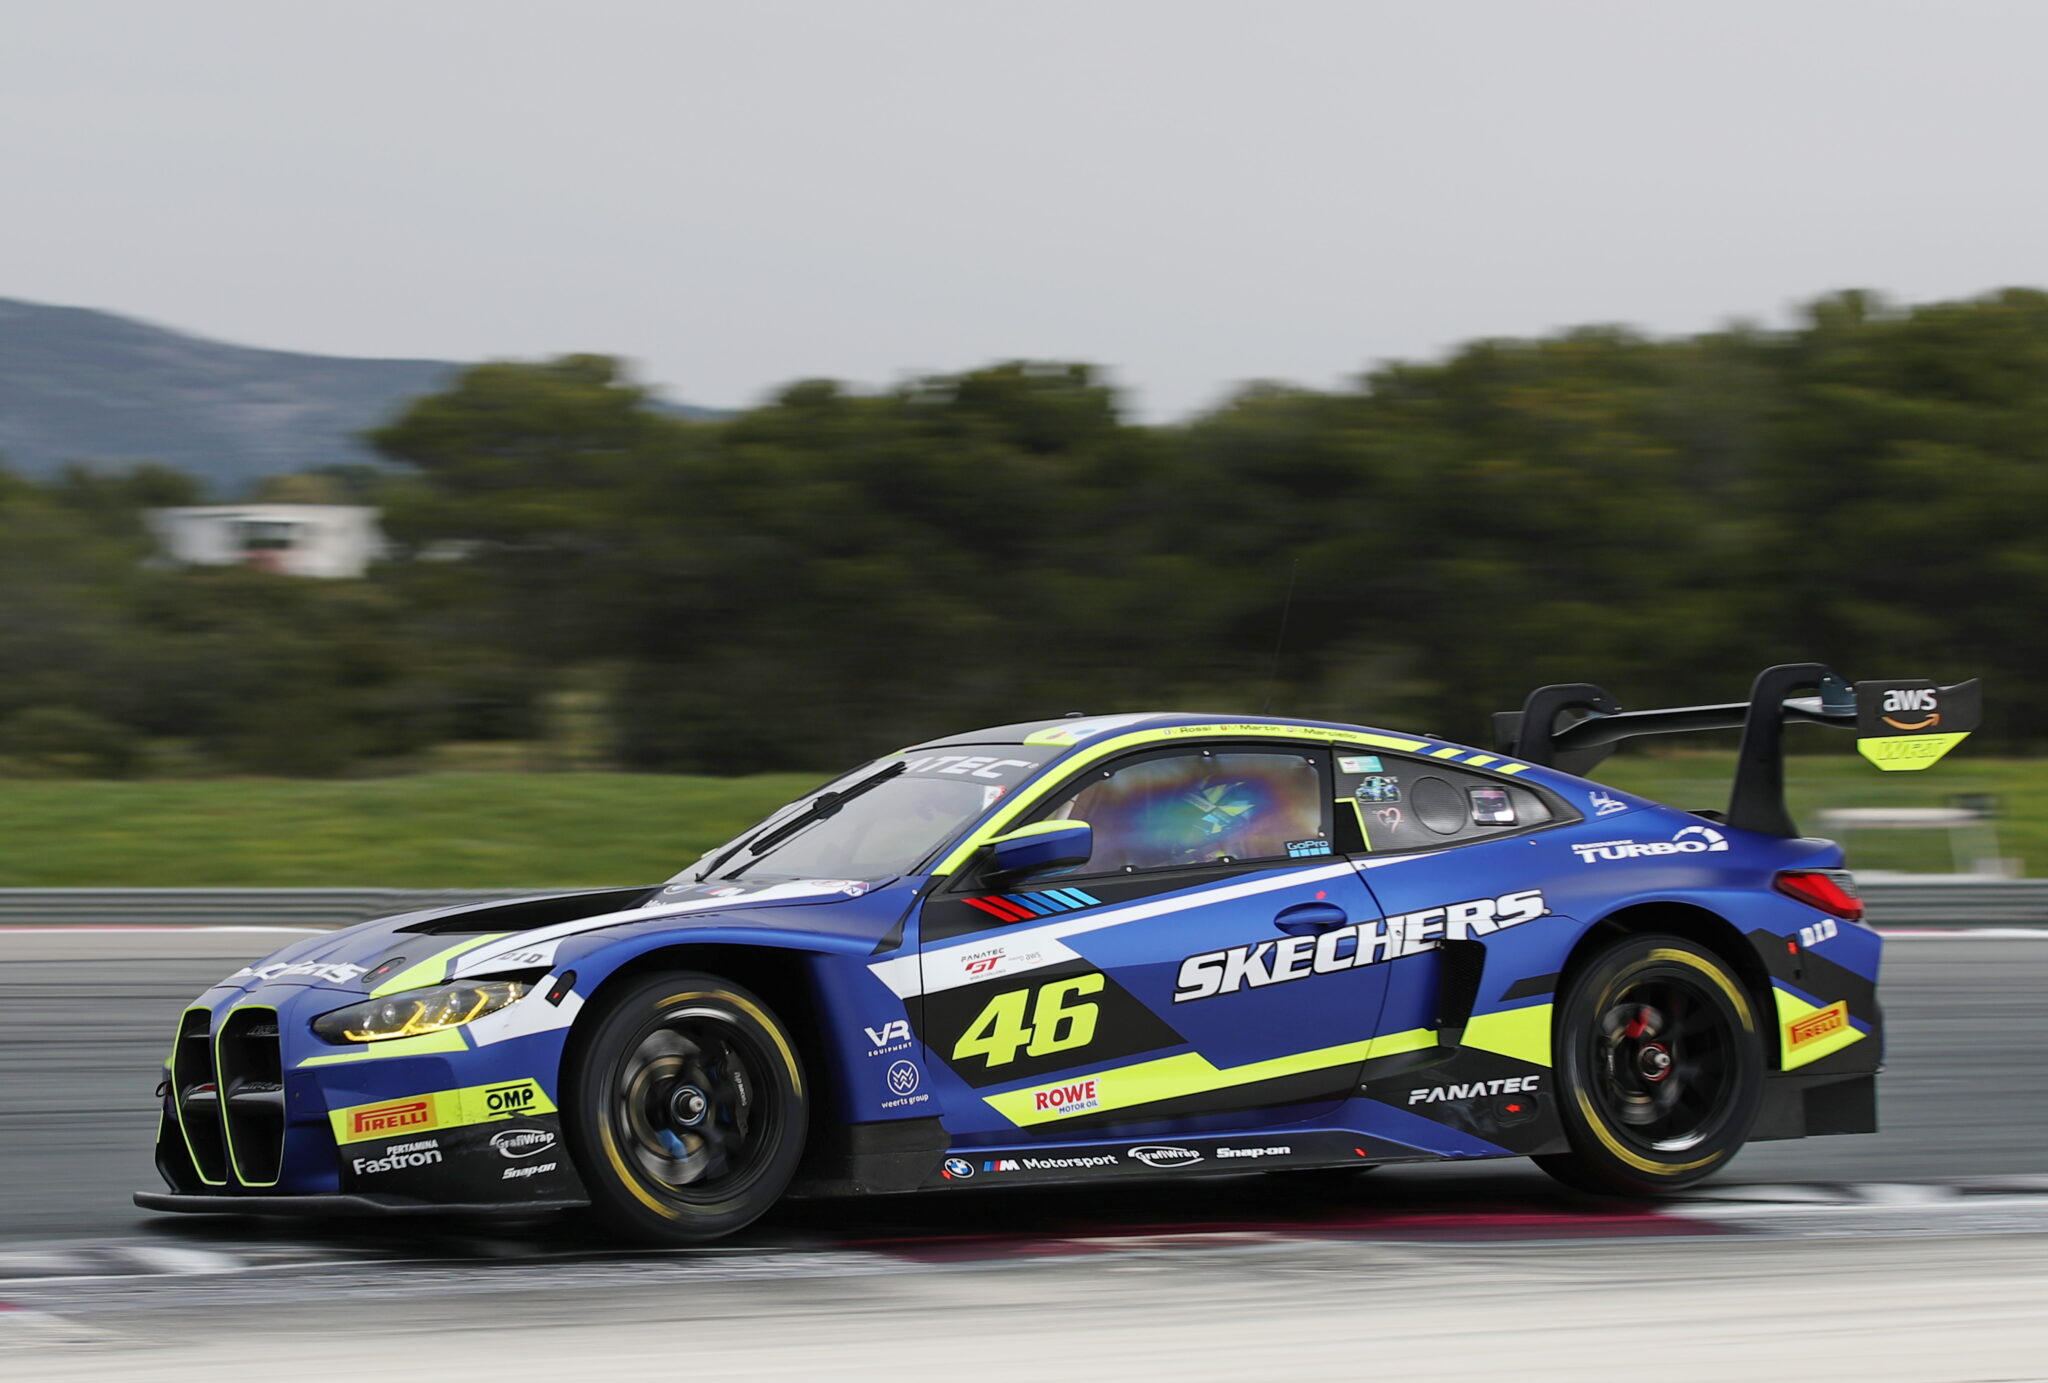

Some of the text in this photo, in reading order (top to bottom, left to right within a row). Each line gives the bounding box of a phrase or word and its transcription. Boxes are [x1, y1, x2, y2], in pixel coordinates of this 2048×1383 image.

[1883, 688, 1938, 712] aws
[1240, 724, 1280, 732] Martin
[1877, 738, 1947, 760] WRT
[1286, 840, 1329, 850] GoPro
[1573, 840, 1708, 864] TURBO
[960, 947, 1005, 962] FANATEC
[1174, 889, 1545, 1003] SKECHERS
[965, 954, 1007, 975] GT
[951, 972, 1106, 1068] 46
[1791, 1008, 1842, 1045] PIRELLI
[864, 1019, 911, 1047] VR
[868, 1041, 913, 1057] EQUIPMENT
[487, 1088, 534, 1110] OMP
[1034, 1080, 1096, 1111] ROWE
[1407, 1075, 1541, 1106] FANATEC
[881, 1094, 929, 1109] weerts group
[1059, 1099, 1099, 1114] MOTOR OIL
[354, 1101, 428, 1134] PIRELLI
[386, 1138, 439, 1155] PERTAMINA
[495, 1131, 555, 1149] GrafiWrap
[352, 1149, 443, 1176] Fastron
[1022, 1154, 1119, 1170] Motorsport
[1216, 1146, 1292, 1159] Snap-on
[502, 1161, 557, 1180] Snap-on
